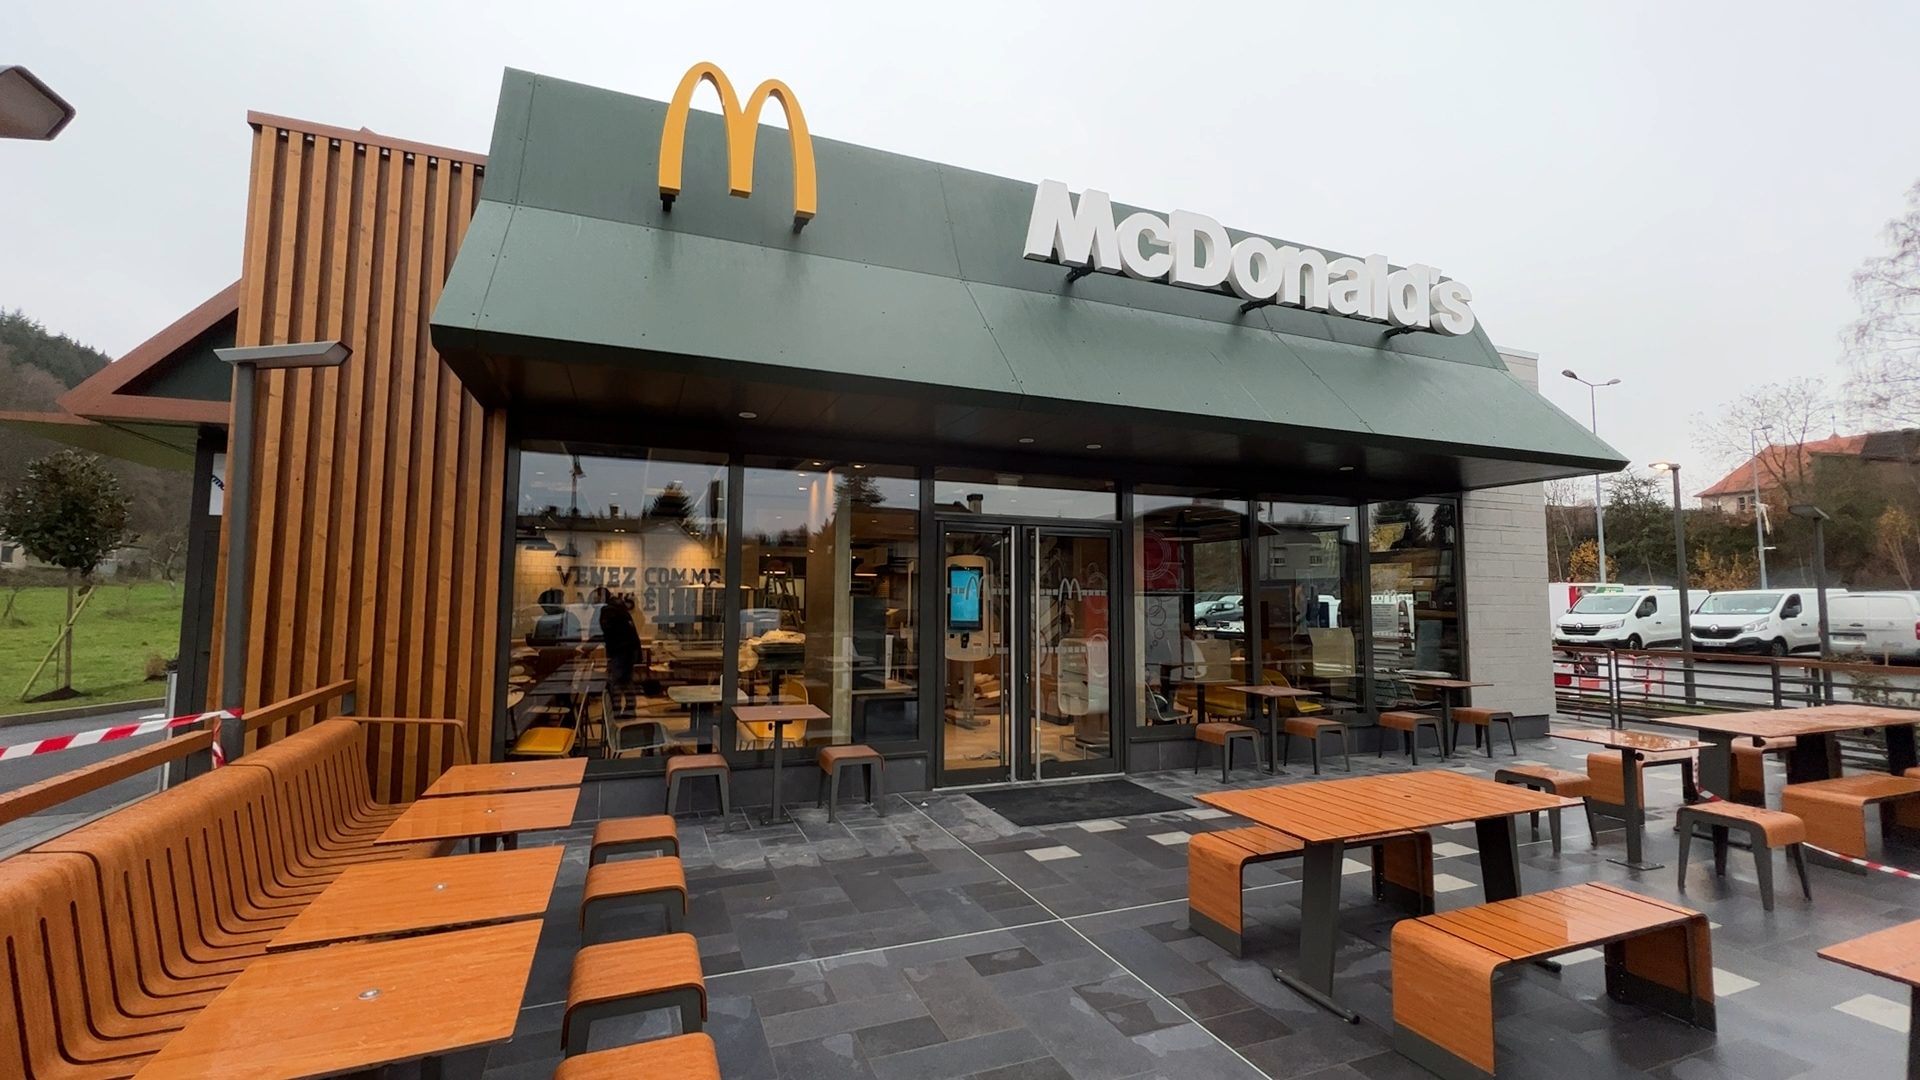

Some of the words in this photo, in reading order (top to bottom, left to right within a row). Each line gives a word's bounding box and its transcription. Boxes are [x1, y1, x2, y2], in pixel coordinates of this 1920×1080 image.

[1023, 178, 1475, 336] McDonald's
[556, 565, 637, 588] VENEZ
[644, 567, 721, 586] COMME
